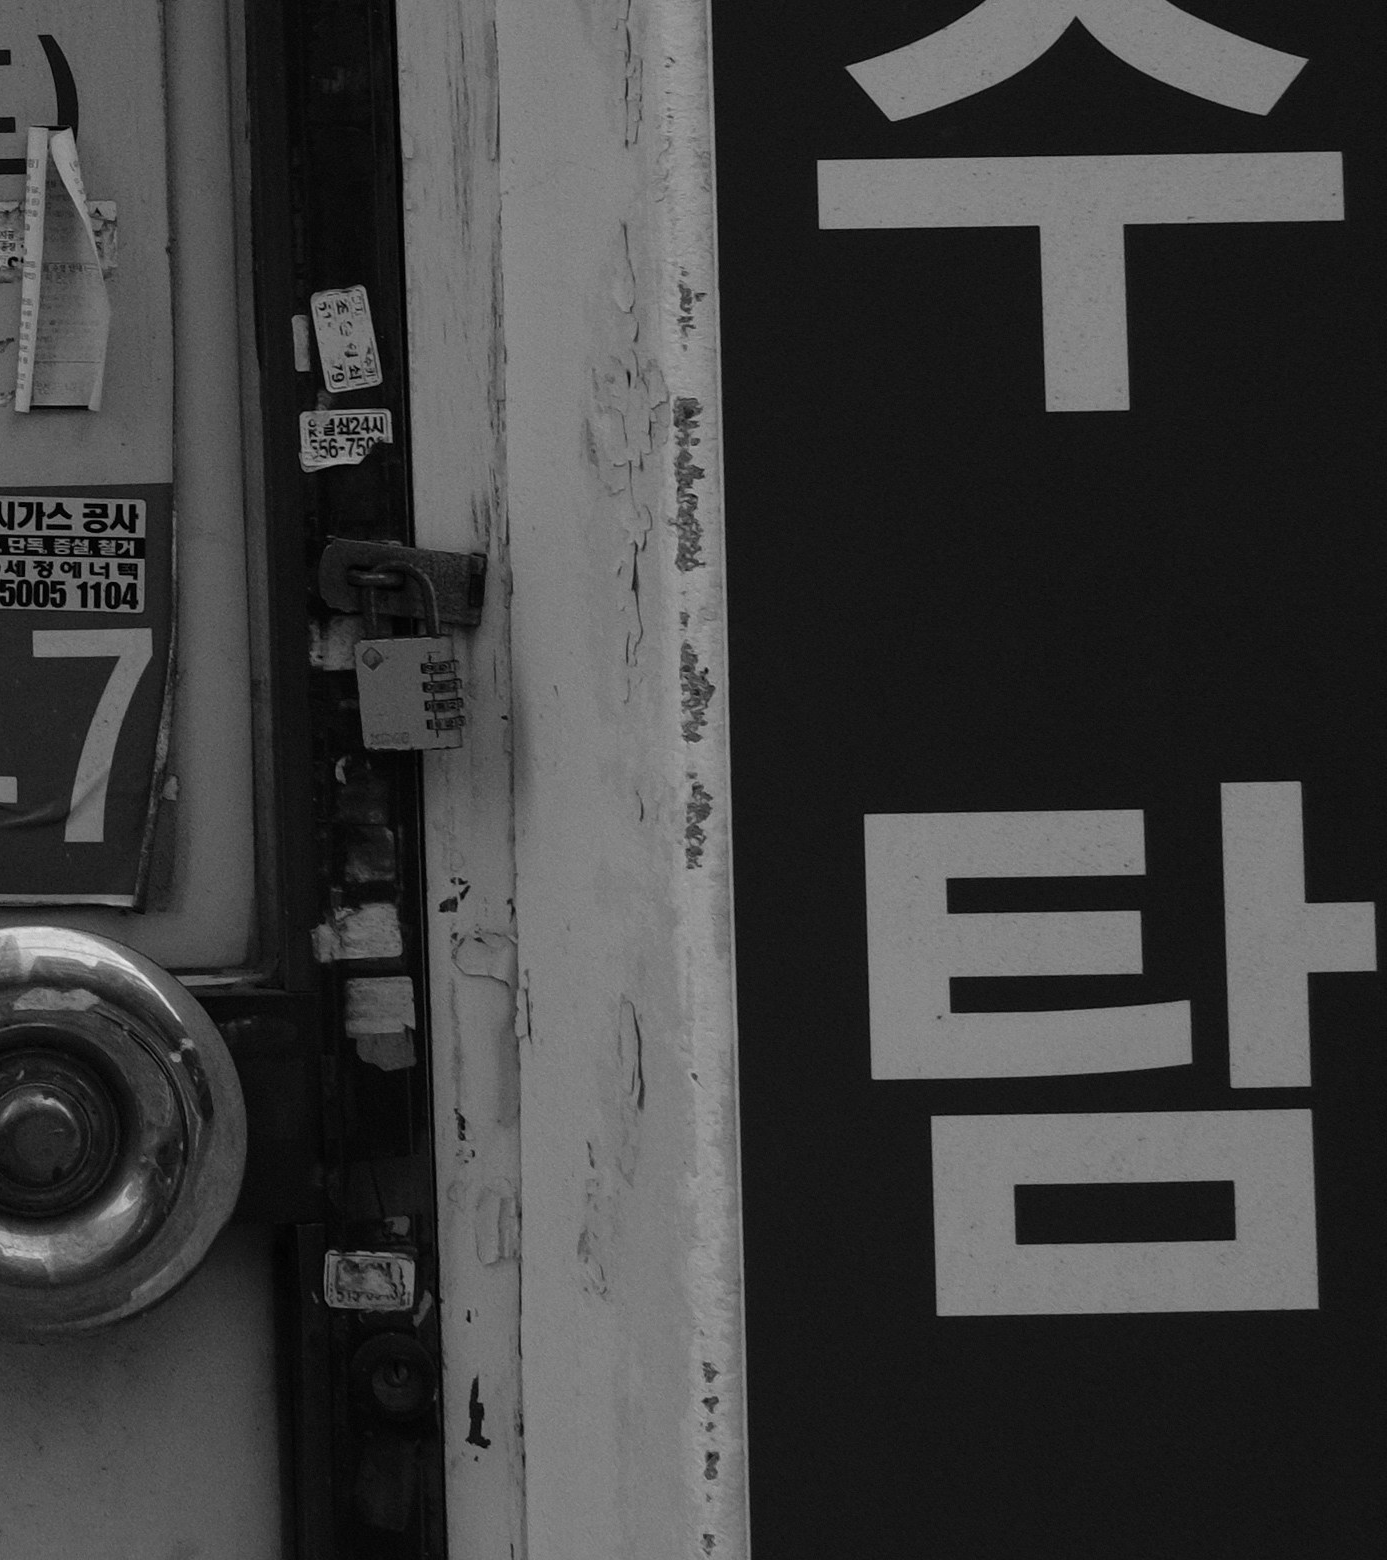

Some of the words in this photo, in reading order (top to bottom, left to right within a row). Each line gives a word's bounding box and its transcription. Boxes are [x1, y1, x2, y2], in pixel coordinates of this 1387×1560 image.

[82, 502, 138, 534] 공사
[0, 579, 67, 608] 5005
[77, 581, 138, 610] 1104
